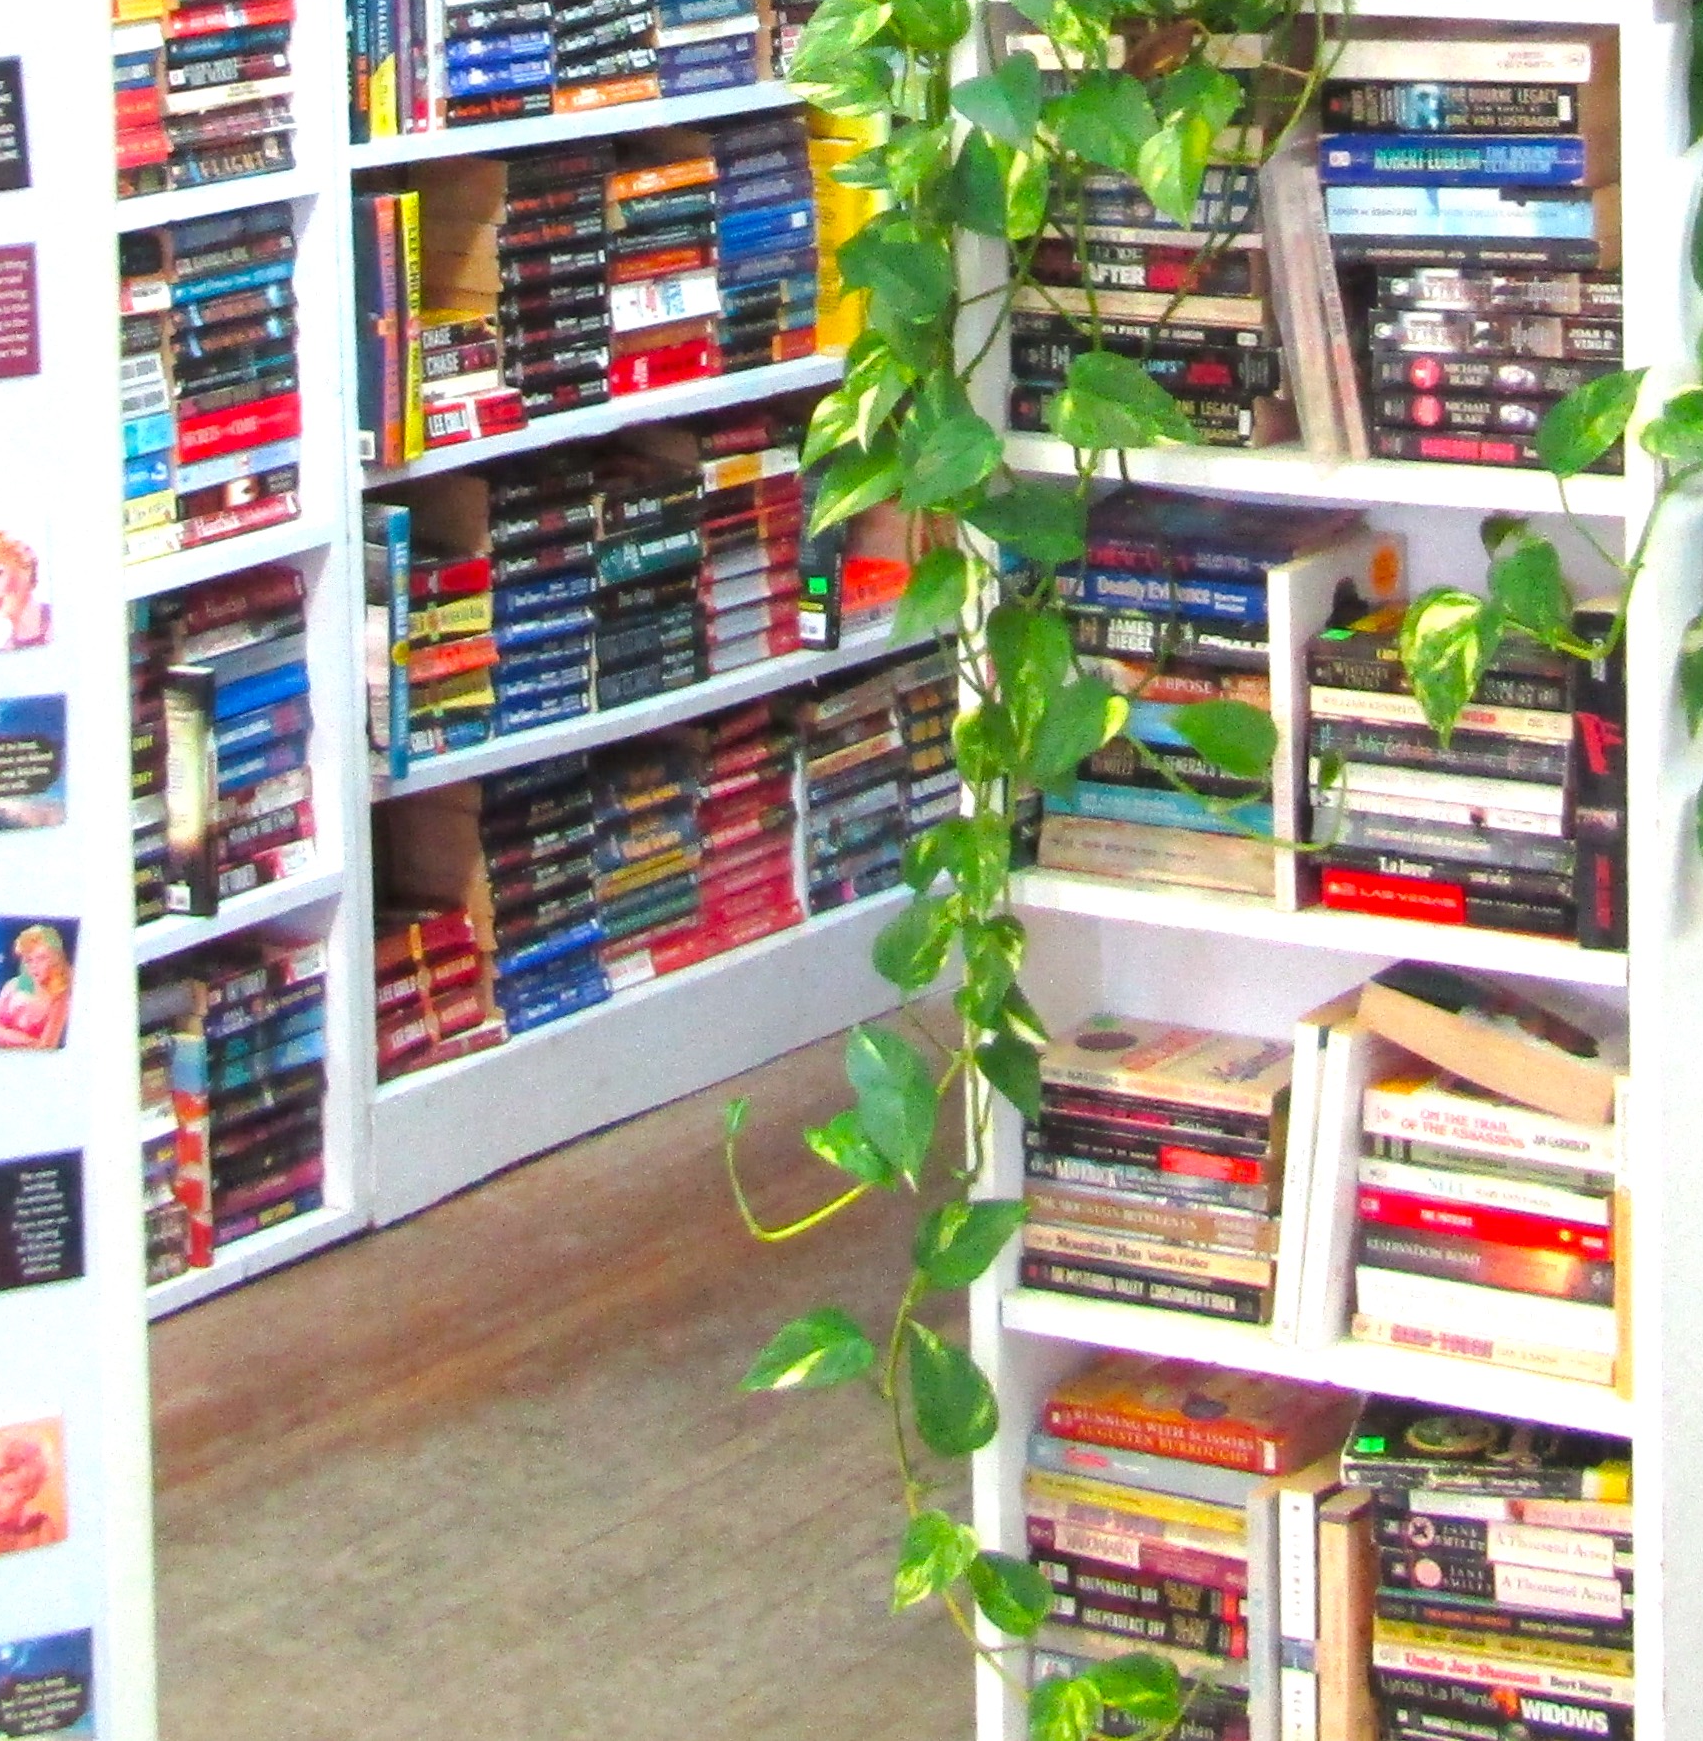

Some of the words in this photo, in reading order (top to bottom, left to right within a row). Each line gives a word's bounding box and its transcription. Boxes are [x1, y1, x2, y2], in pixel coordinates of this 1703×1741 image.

[1516, 88, 1559, 105] LEGACY
[1374, 148, 1425, 171] ROBERT
[422, 326, 452, 352] CHASE
[424, 352, 460, 377] CHASE
[1444, 363, 1491, 377] MICHAEL
[1450, 374, 1484, 387] BLAKE
[1444, 402, 1491, 414] MICHAEL
[1450, 412, 1487, 425] BLAKE
[1097, 574, 1147, 602] Deadly
[1106, 617, 1155, 638] JAMES
[1106, 632, 1155, 655] SIEGEL
[1400, 1116, 1418, 1131] OF
[1422, 1120, 1448, 1136] THE
[1419, 1107, 1443, 1121] ON
[1444, 1111, 1470, 1126] THE
[1472, 1117, 1509, 1133] TRAIL
[1073, 1408, 1141, 1433] RUNNING
[1146, 1420, 1185, 1439] WITH
[1189, 1428, 1255, 1452] SCISSORS
[1077, 1422, 1157, 1448] AUGUSTEN
[1158, 1437, 1249, 1465] BURROUGHS
[1444, 1522, 1480, 1539] JANE
[1573, 1543, 1610, 1562] Acres
[1449, 1564, 1484, 1580] JANE
[1517, 1577, 1580, 1599] Thousand
[1582, 1585, 1620, 1605] Acres
[1147, 1619, 1167, 1638] DAY
[1404, 1651, 1445, 1672] Uncle
[1446, 1658, 1474, 1676] Joe
[1476, 1661, 1542, 1686] Shannon
[1379, 1673, 1426, 1697] Lynda
[1429, 1683, 1449, 1700] La
[1178, 1714, 1216, 1741] plan
[1521, 1698, 1610, 1734] WIDOWS
